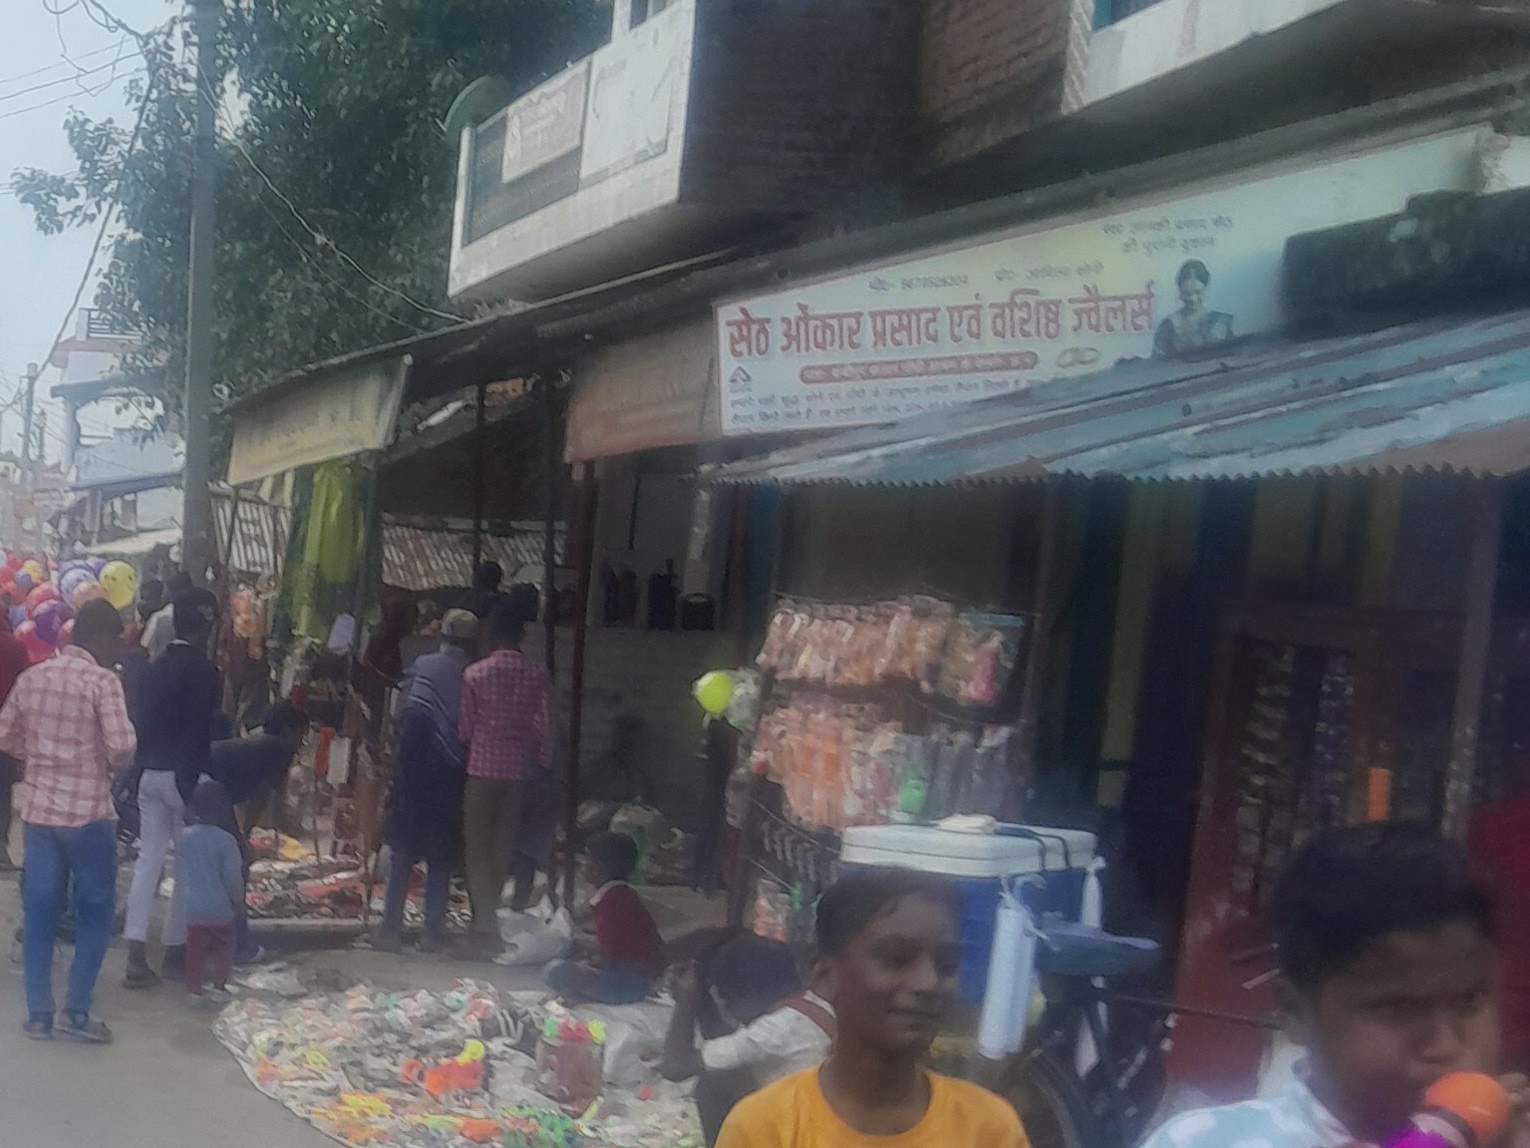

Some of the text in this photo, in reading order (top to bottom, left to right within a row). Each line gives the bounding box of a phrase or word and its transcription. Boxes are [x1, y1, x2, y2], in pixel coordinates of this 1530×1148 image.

[726, 306, 771, 357] सेठ
[868, 306, 941, 349] प्रसाद
[946, 292, 983, 343] एवं
[988, 287, 1063, 340] वशिष्ठ
